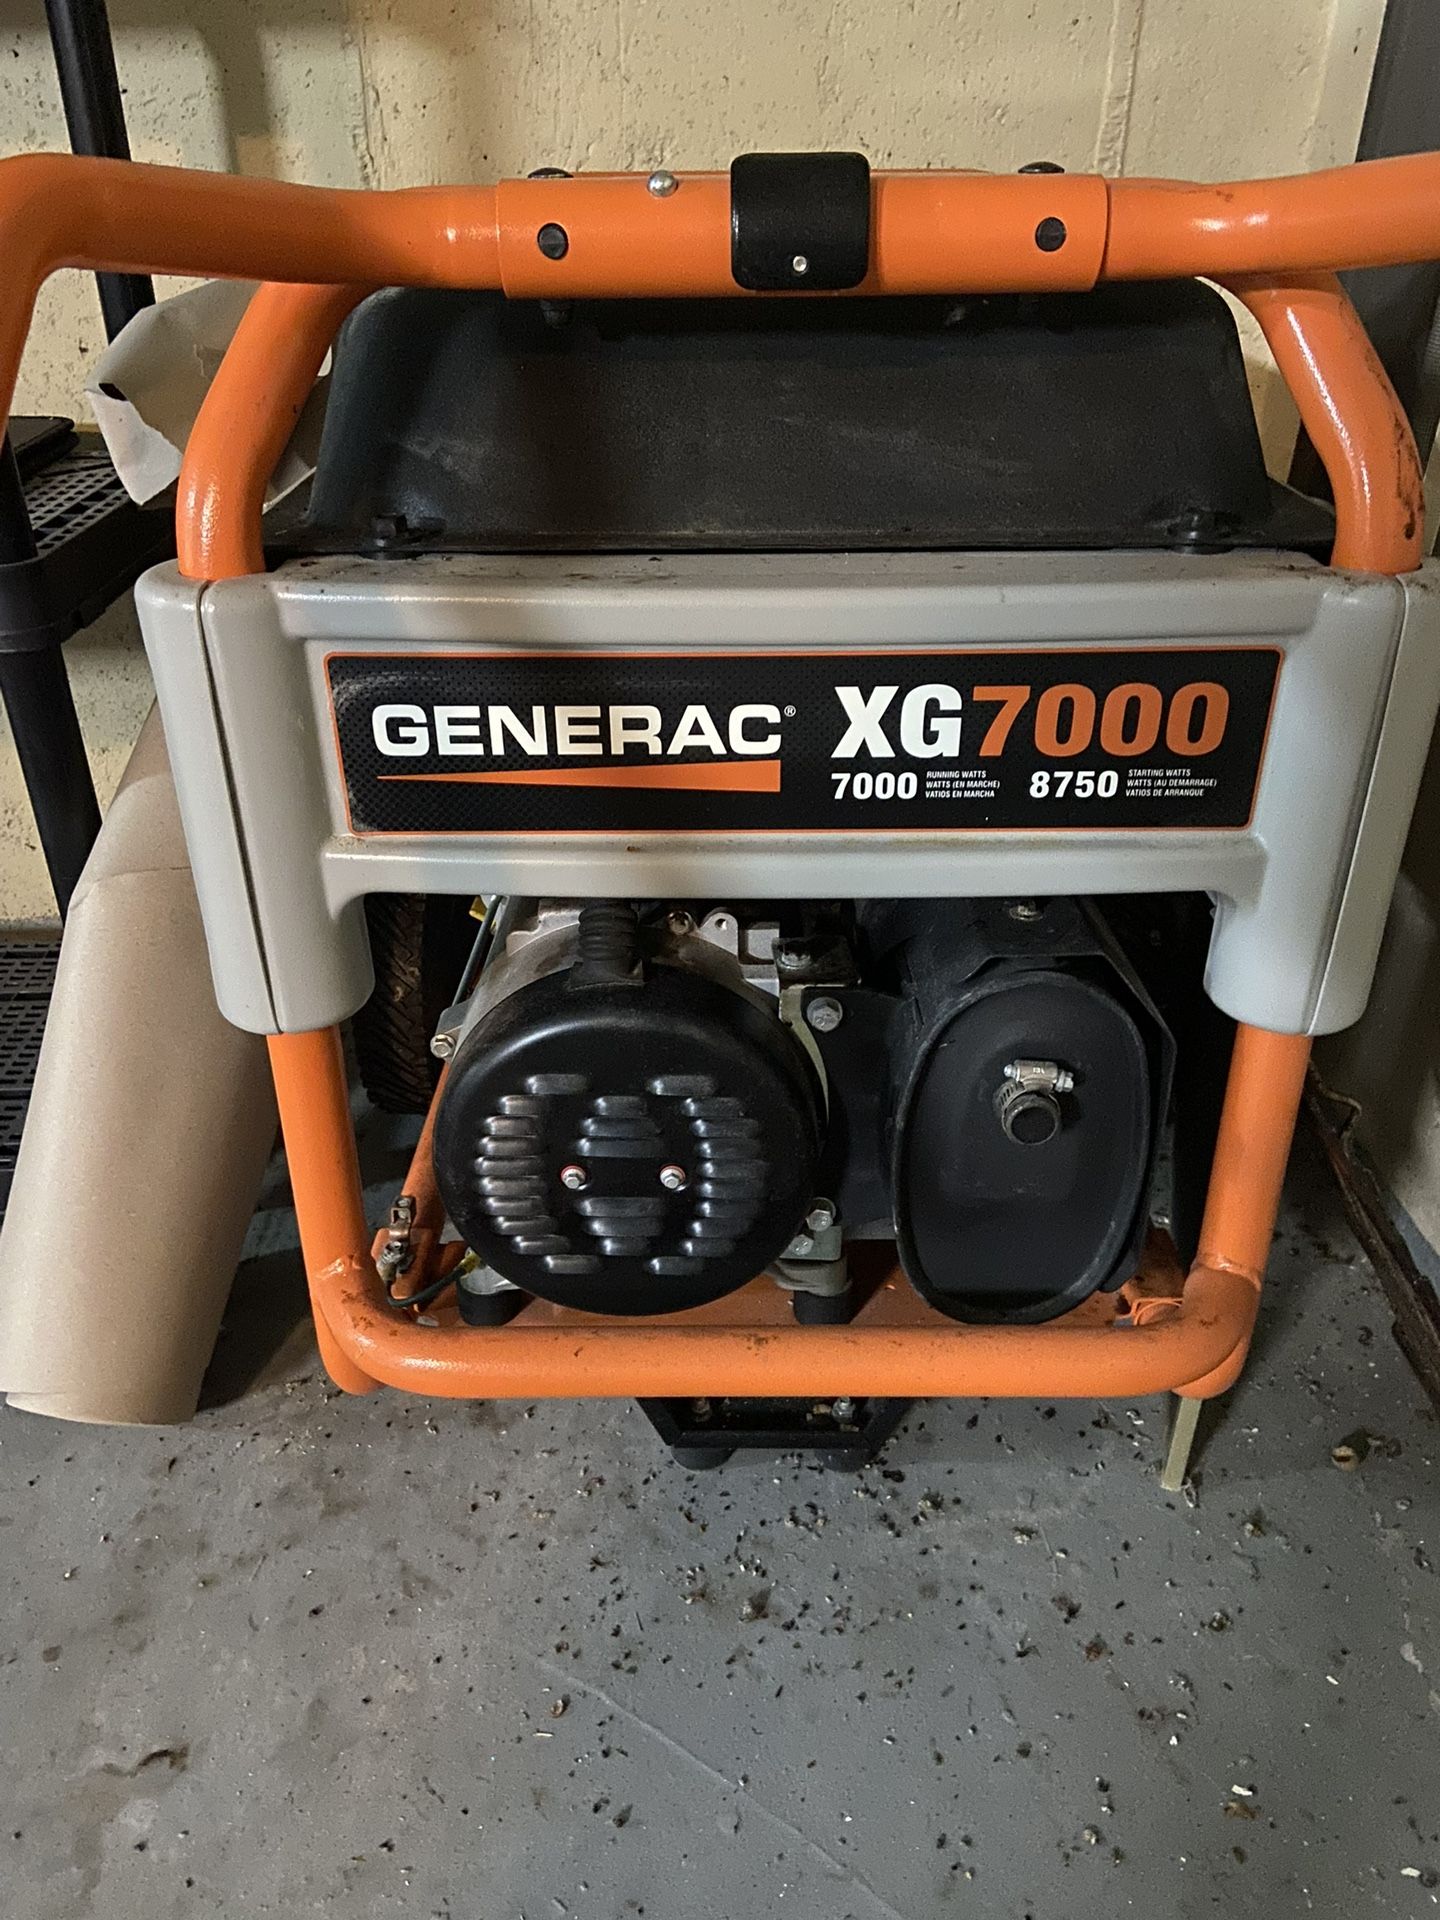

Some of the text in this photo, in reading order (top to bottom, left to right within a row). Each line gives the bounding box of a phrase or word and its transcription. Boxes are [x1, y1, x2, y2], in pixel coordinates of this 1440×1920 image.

[831, 683, 1230, 759] XG7000
[371, 704, 782, 757] GENERAC
[926, 770, 987, 779] RUNNING WATTS
[1128, 768, 1191, 777] STARTING WATTS
[830, 771, 918, 800] 7000
[926, 780, 1001, 789] WATTS (EN MARCHE)
[1029, 769, 1119, 799] 8750
[1126, 779, 1152, 788] WATTS
[1153, 779, 1167, 788] (AU
[925, 790, 995, 798] VATIOS EN MARCHA
[1125, 788, 1205, 797] VATIOS DE ARRANQUE
